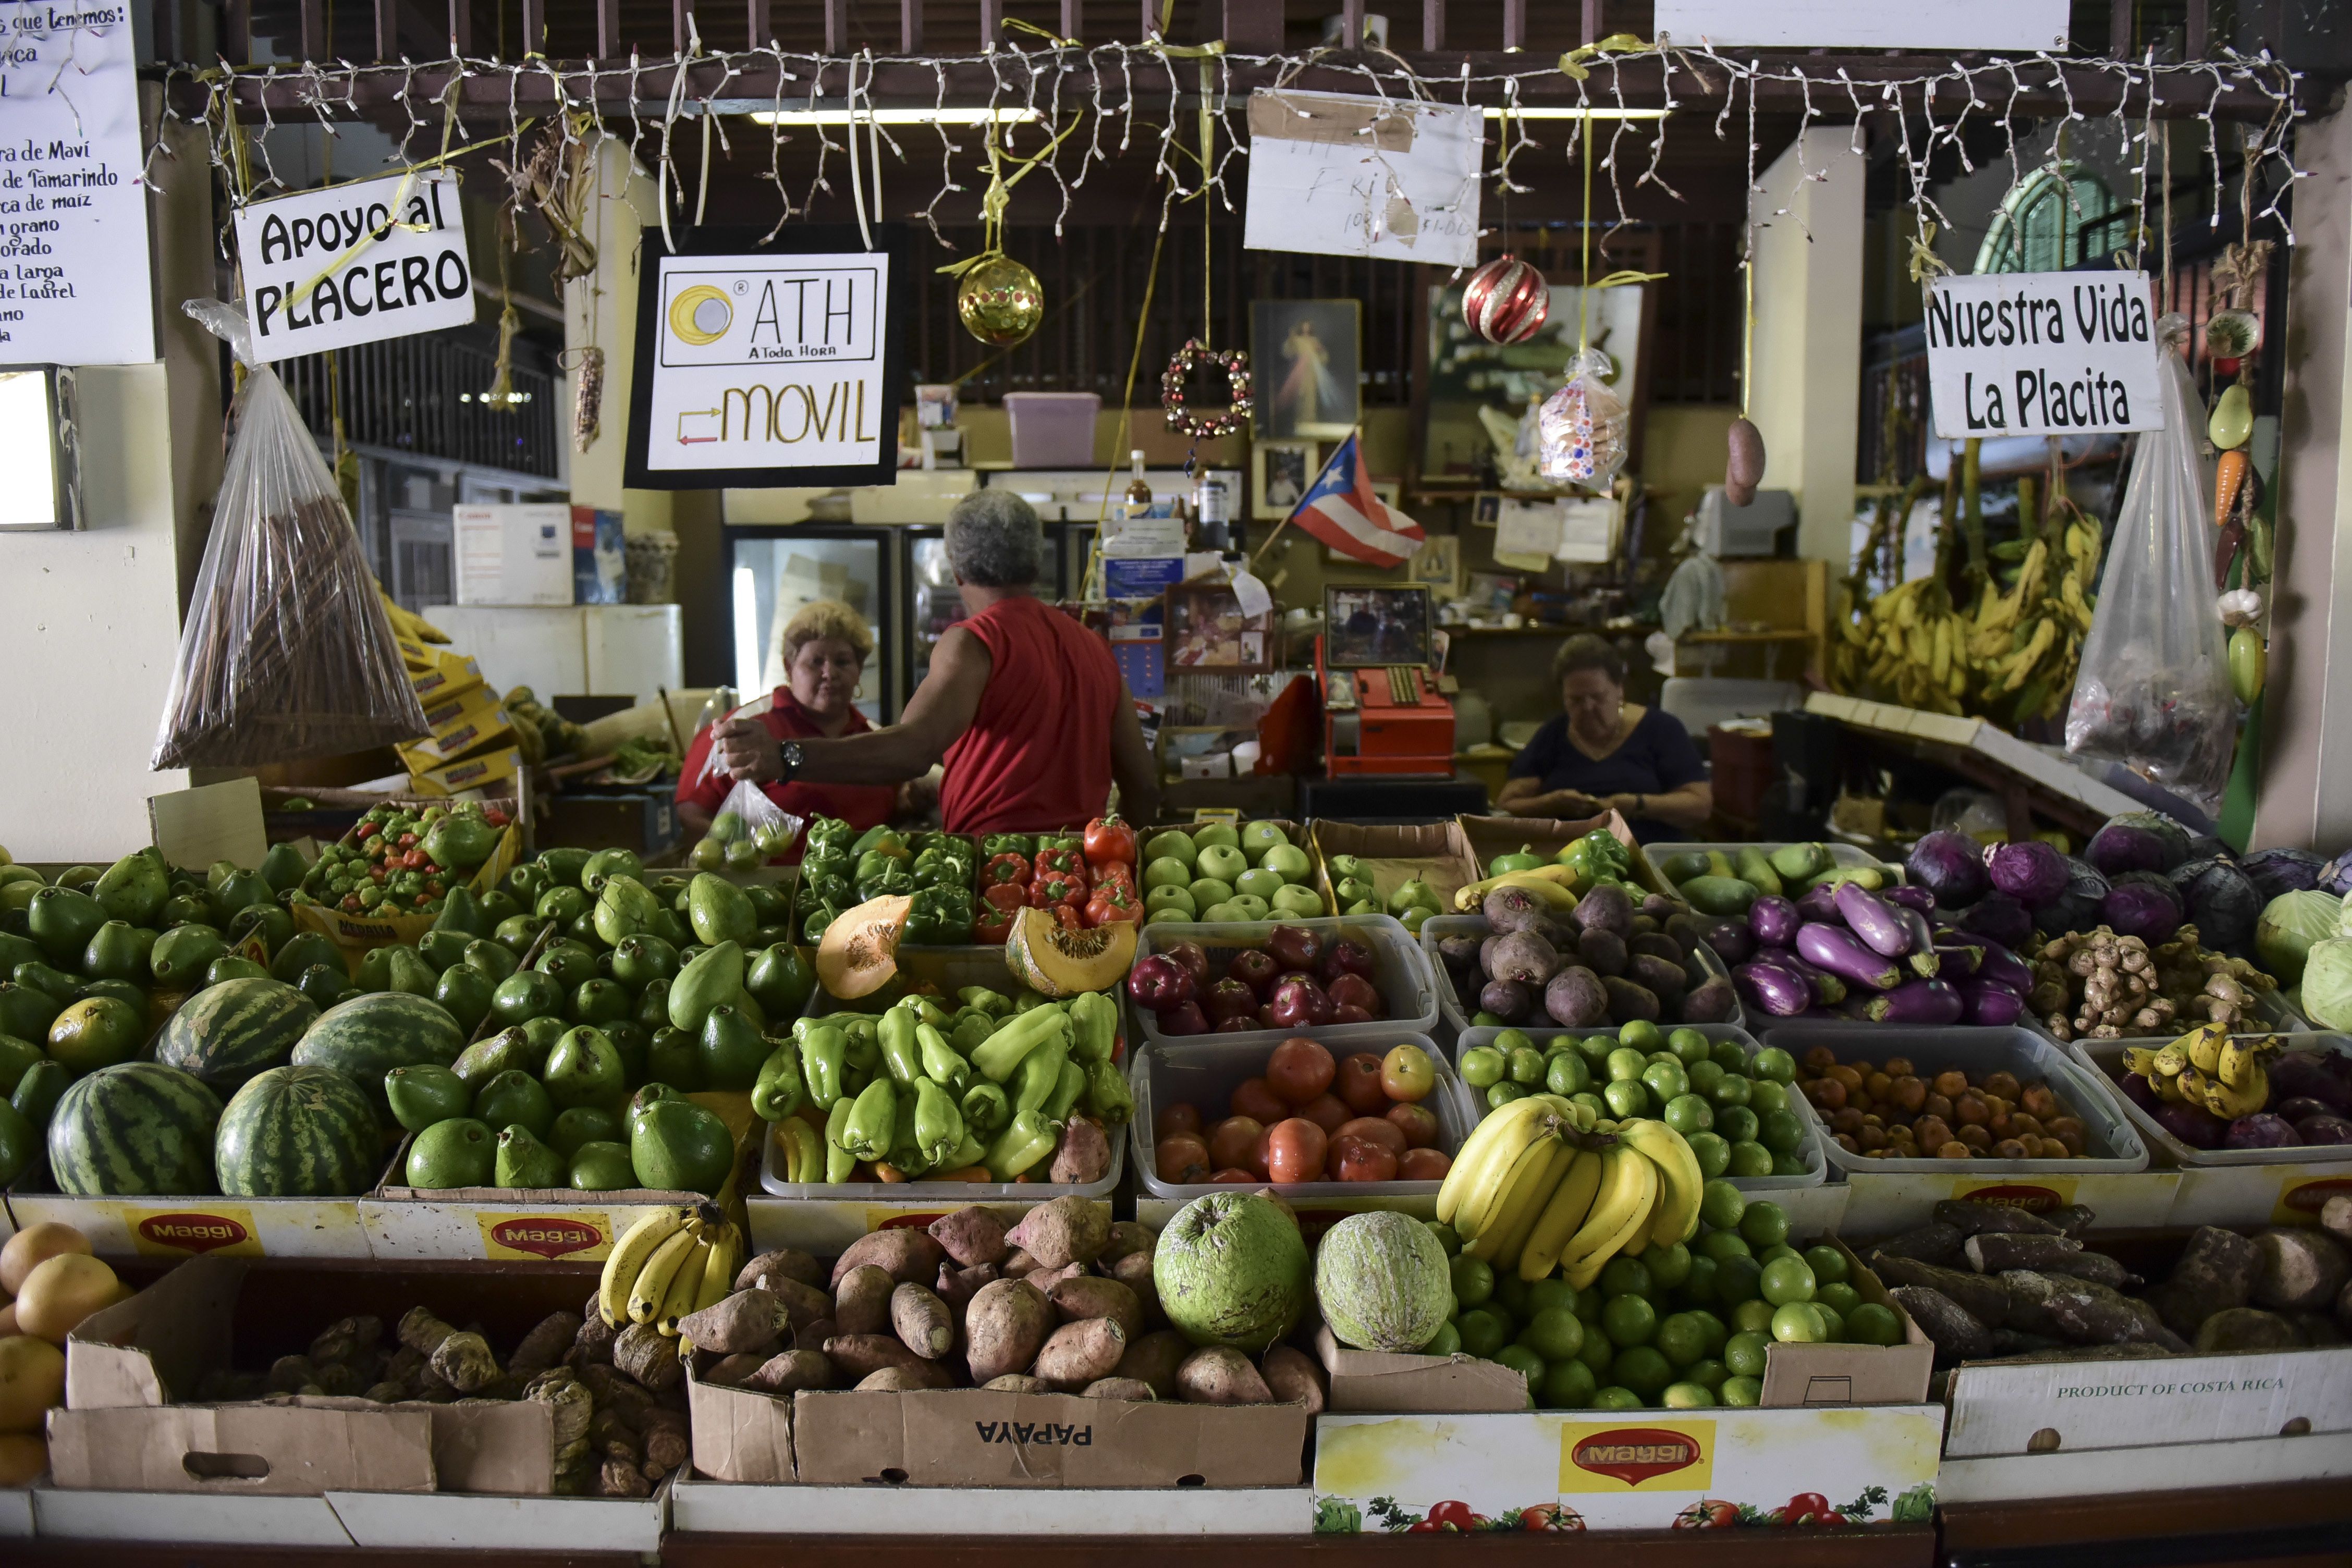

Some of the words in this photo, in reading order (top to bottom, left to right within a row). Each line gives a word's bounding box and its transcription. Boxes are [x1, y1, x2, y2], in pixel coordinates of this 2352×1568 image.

[13, 16, 42, 31] que
[21, 139, 44, 161] de
[48, 140, 90, 161] Maví
[3, 169, 23, 188] de
[28, 163, 118, 188] Tamarindo
[26, 193, 44, 211] de
[51, 193, 92, 210] maíz
[9, 219, 59, 247] grano
[14, 264, 64, 290] larga
[20, 282, 77, 299] Laurel
[255, 249, 469, 337] PLACERO
[751, 278, 852, 345] ATH
[1929, 289, 2065, 348] Nuestra
[2074, 283, 2149, 344] Vida
[749, 348, 759, 359] A
[761, 346, 793, 358] Toda
[1965, 372, 2006, 430] La
[2016, 367, 2130, 427] Placita
[151, 1224, 234, 1239] Maggi
[505, 1228, 587, 1243] Maggi
[2056, 1385, 2148, 1399] PRODUCT
[2152, 1383, 2177, 1395] OF
[2180, 1380, 2236, 1393] COSTA
[2241, 1377, 2284, 1391] RICA
[975, 1421, 1092, 1446] PAPAYA
[1589, 1445, 1686, 1463] Maggi
